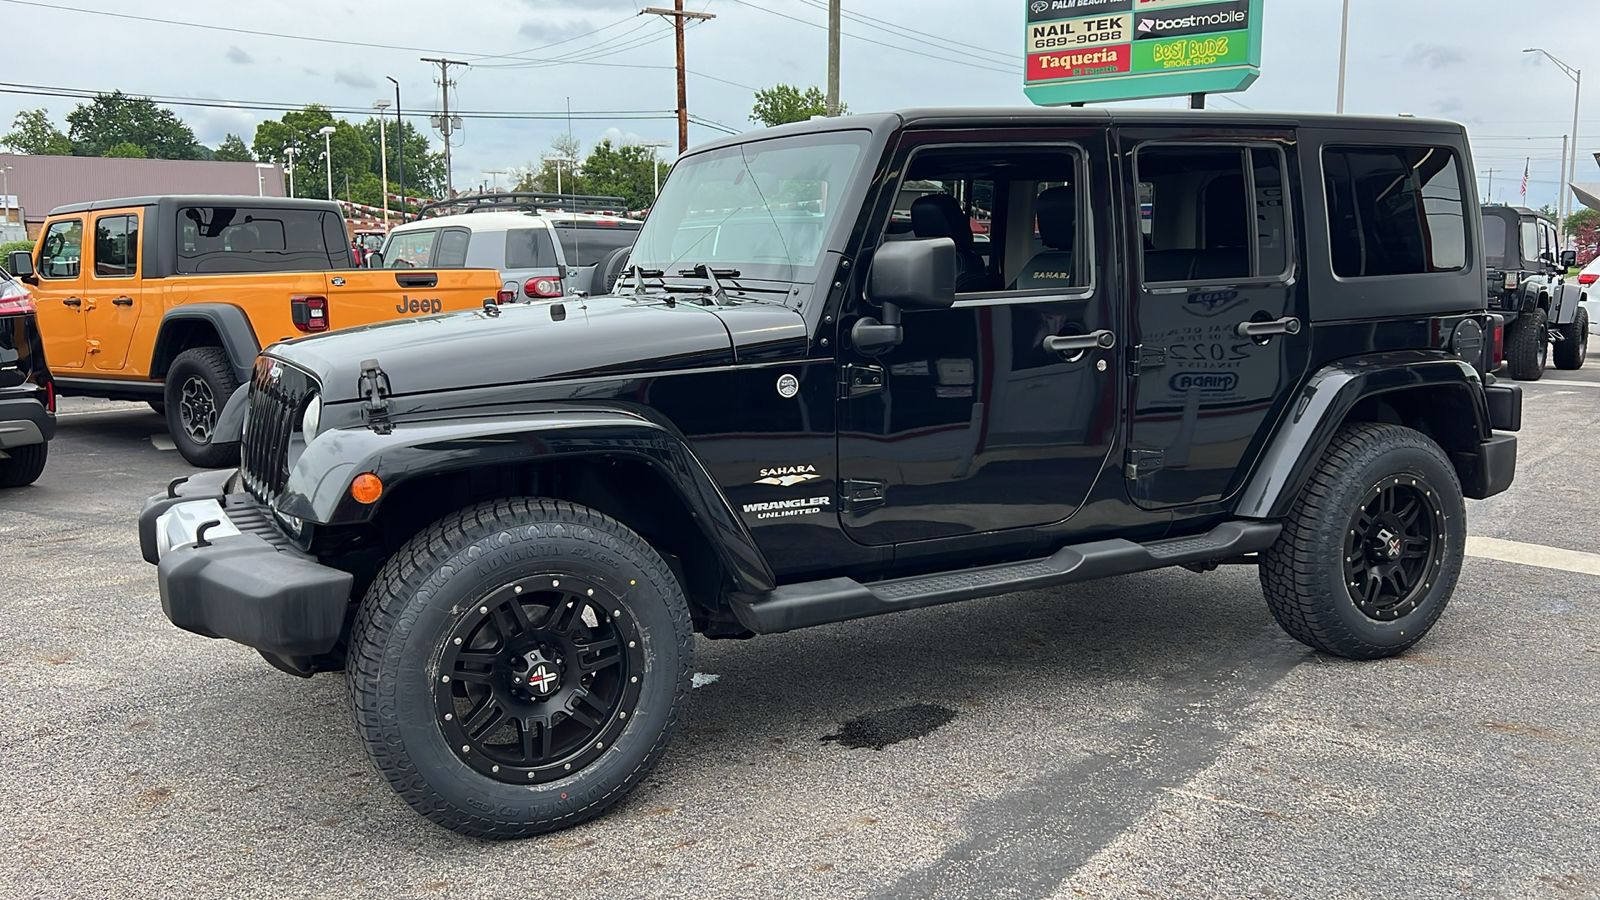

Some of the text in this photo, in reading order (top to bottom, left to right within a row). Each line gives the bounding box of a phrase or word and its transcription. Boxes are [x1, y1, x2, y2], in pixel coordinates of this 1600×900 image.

[1051, 0, 1076, 10] PALM
[1033, 17, 1123, 38] NAIL TEK
[1035, 31, 1122, 48] 689-9088
[1193, 57, 1216, 66] SHOP
[396, 295, 442, 314] Jeep
[759, 464, 816, 477] SAHARA
[742, 496, 830, 513] WRANGLER
[757, 507, 821, 519] UNLIMITED
